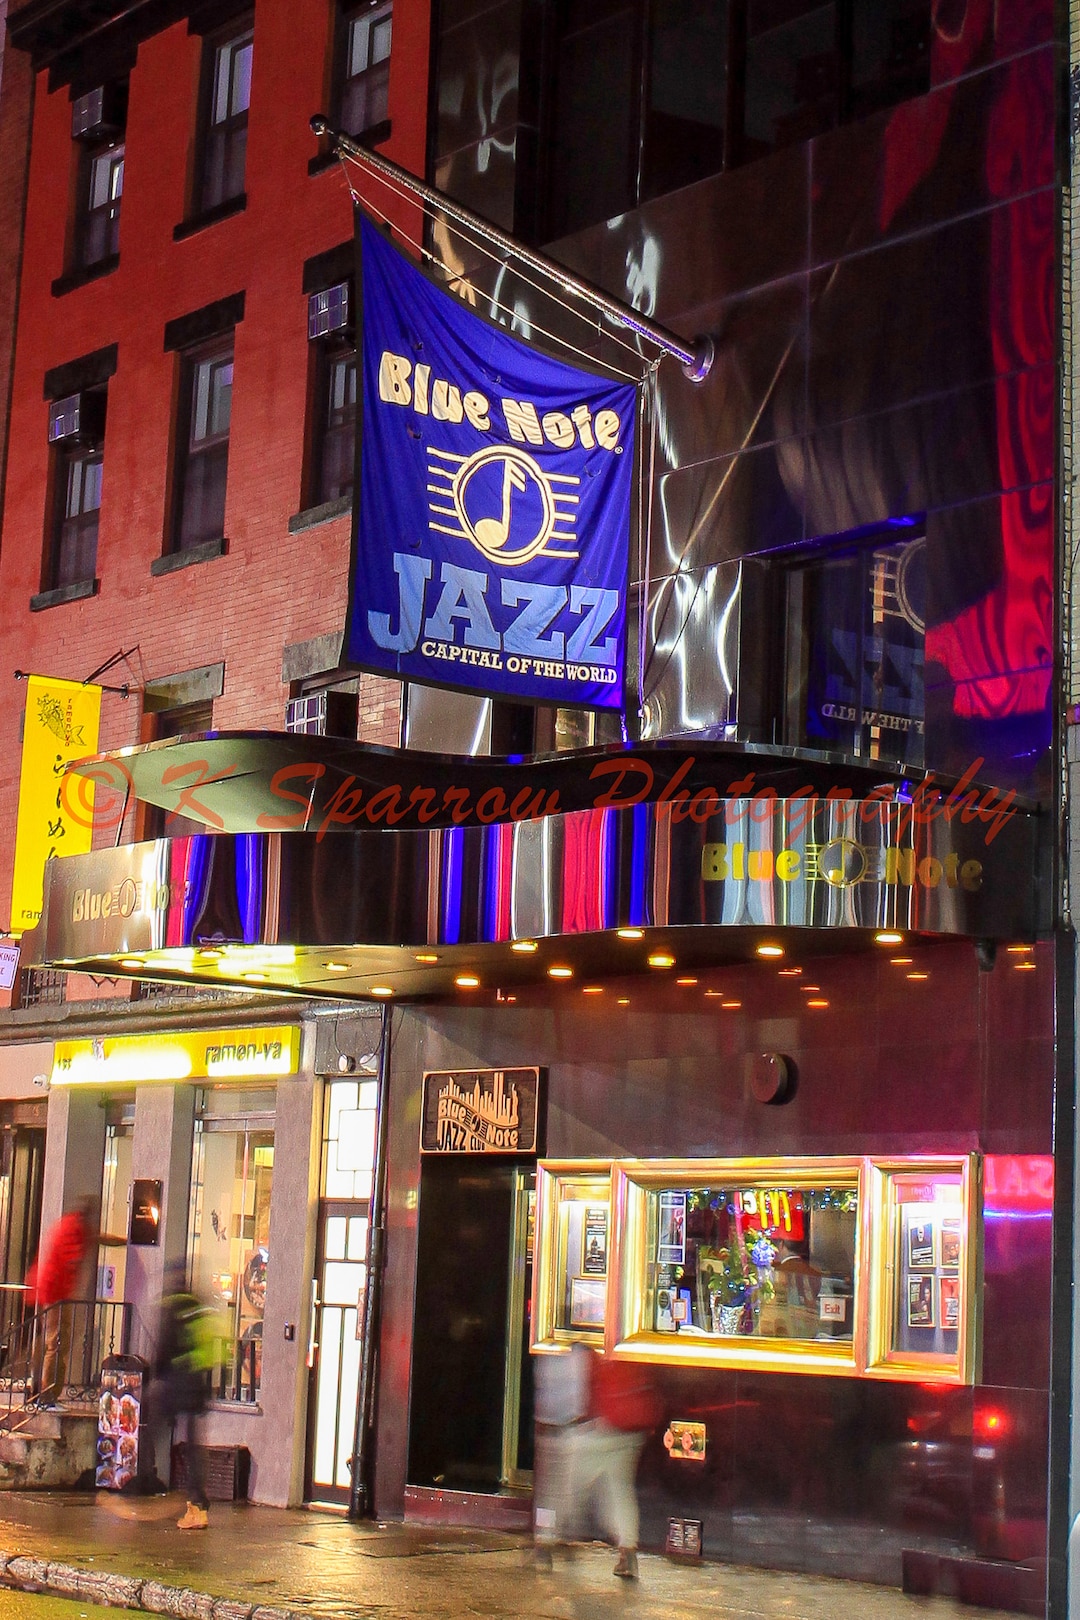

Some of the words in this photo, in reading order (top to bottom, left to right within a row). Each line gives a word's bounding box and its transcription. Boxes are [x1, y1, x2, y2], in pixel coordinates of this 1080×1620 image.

[378, 350, 491, 431] Blue
[367, 552, 619, 666] JAZZ
[421, 641, 503, 670] CAPITAL
[506, 657, 531, 675] OF
[531, 661, 565, 680] THE
[566, 663, 618, 684] WORLD
[702, 842, 800, 882] Blue
[885, 847, 984, 892] Note
[72, 888, 112, 922] Blue
[439, 1099, 467, 1122] Blue
[486, 1124, 519, 1147] Note
[823, 1303, 842, 1315] Exit
